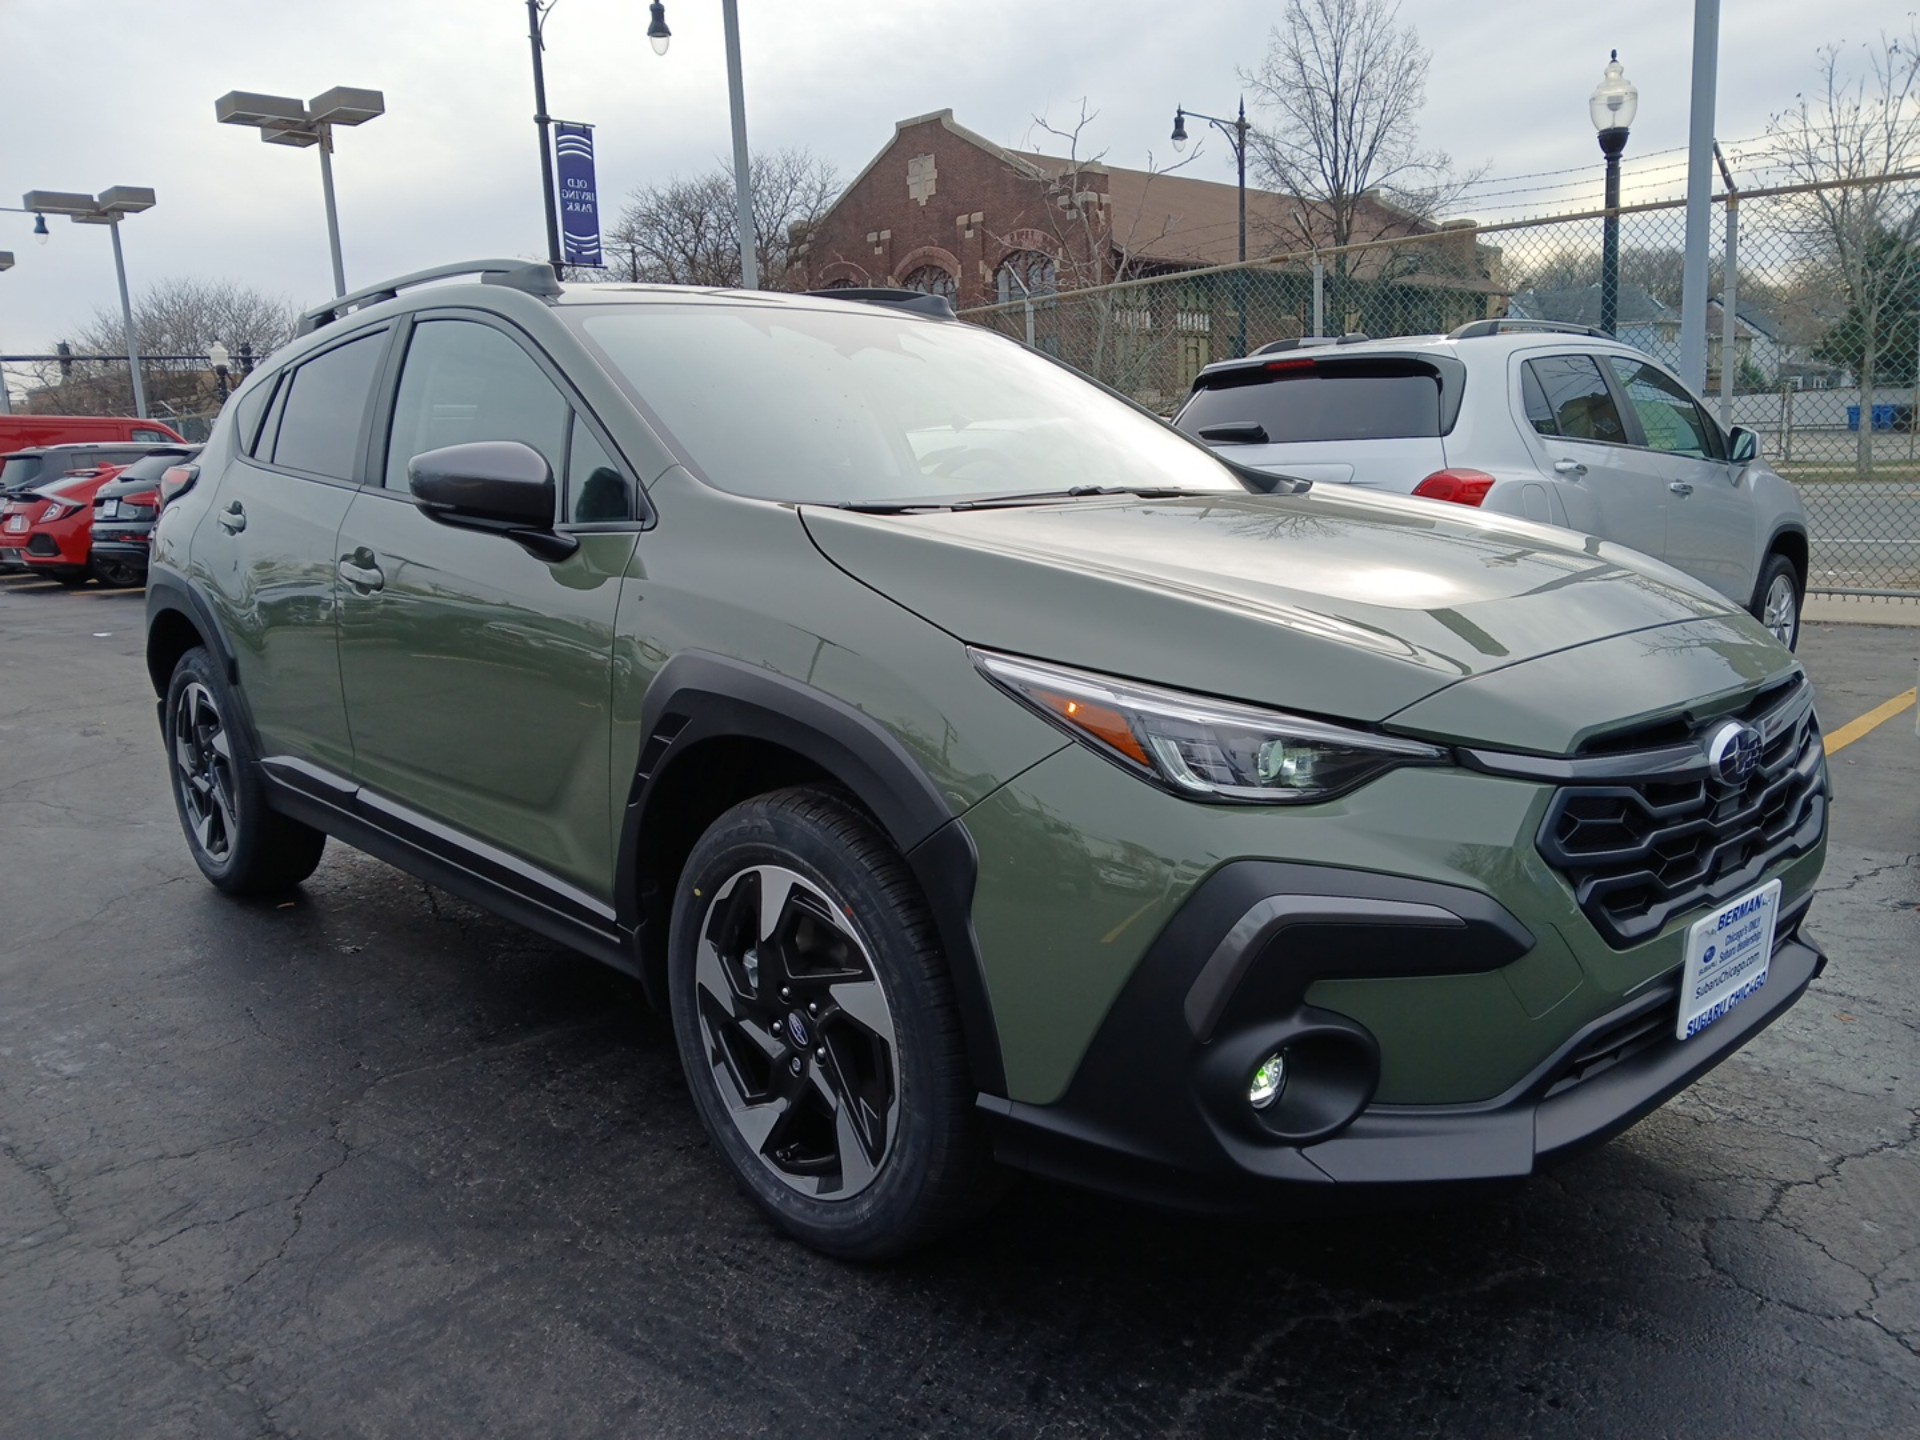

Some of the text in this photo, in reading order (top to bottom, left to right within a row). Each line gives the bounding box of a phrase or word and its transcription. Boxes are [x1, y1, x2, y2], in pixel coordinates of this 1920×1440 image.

[1717, 893, 1763, 931] BERMAN
[1695, 951, 1760, 1000] SubaruChicago.com
[1686, 971, 1766, 1040] SUBARU CHICAGO
